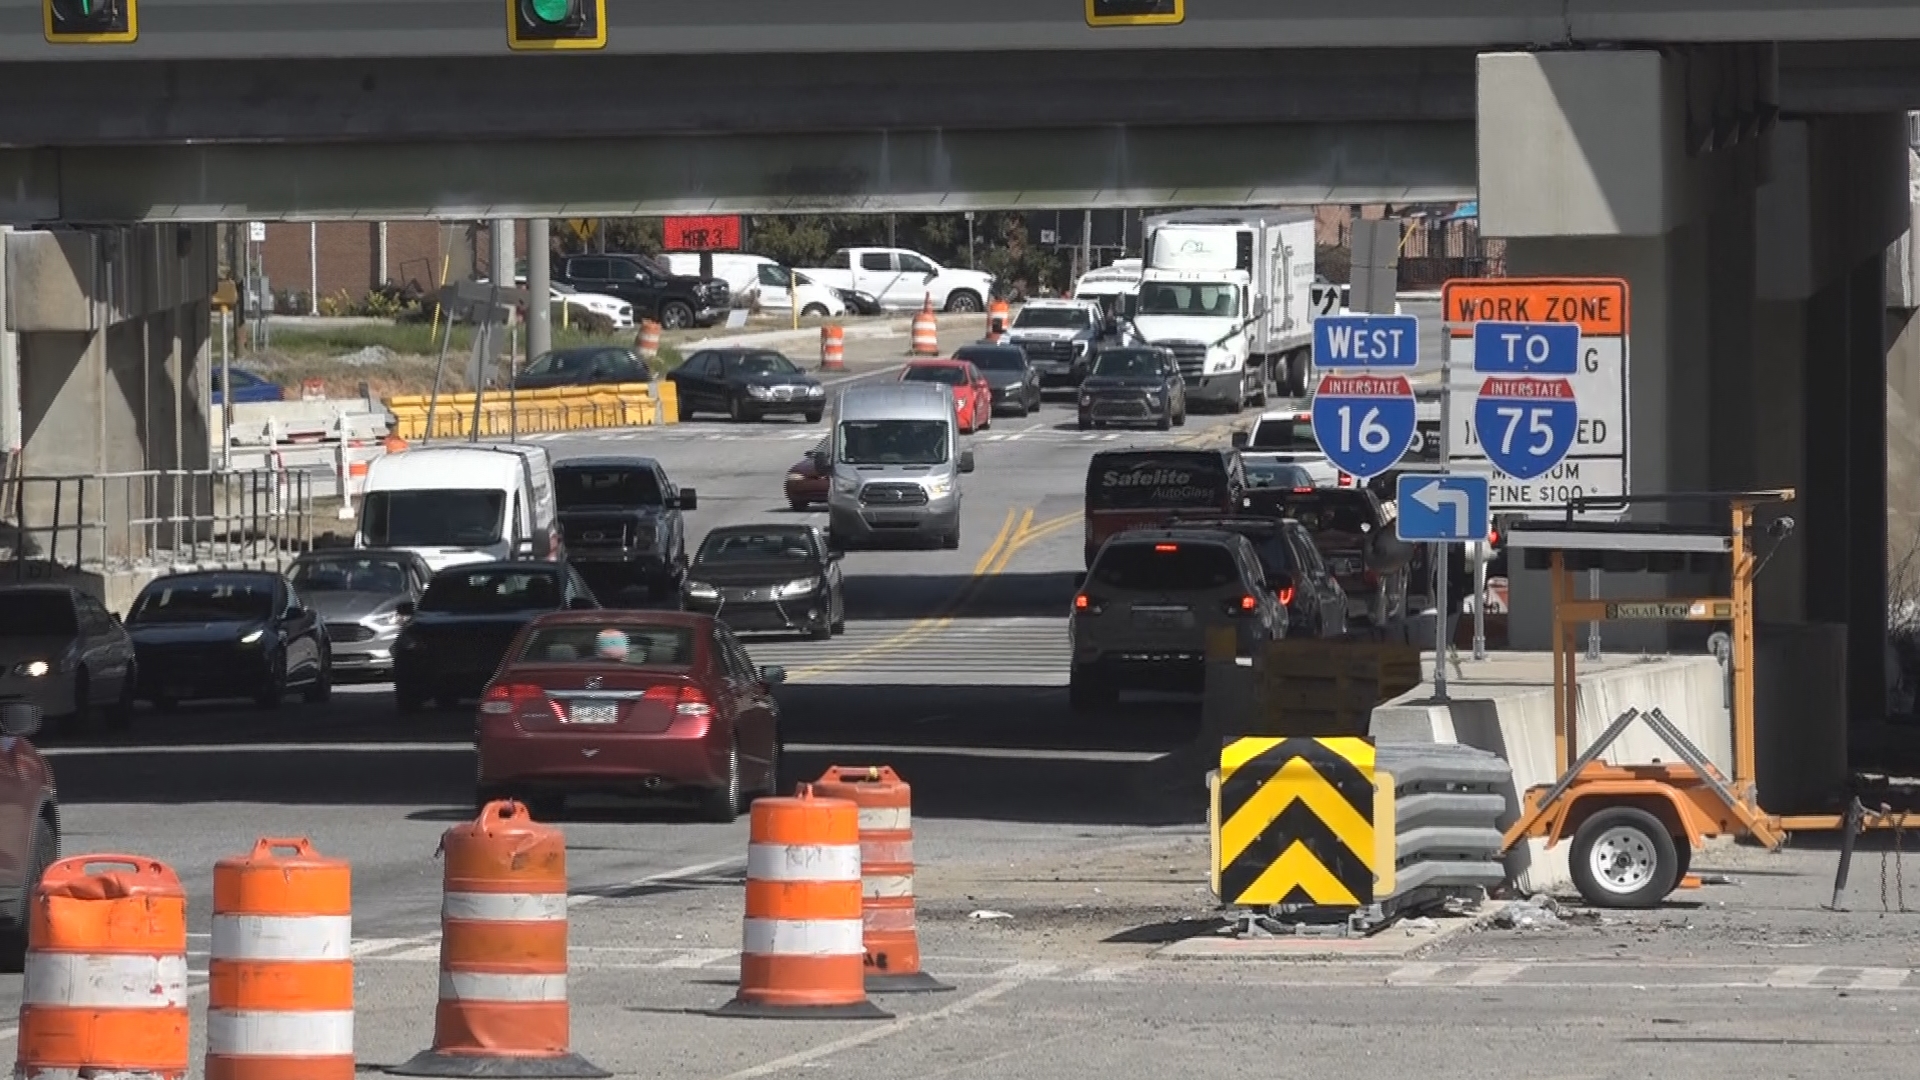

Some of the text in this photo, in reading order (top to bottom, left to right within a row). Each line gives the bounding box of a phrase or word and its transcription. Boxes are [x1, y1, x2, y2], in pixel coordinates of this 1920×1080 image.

[1458, 296, 1612, 321] WORK ZONE
[1327, 325, 1404, 359] WEST
[1500, 333, 1550, 363] TO
[1328, 380, 1401, 395] INTERSTATE
[1490, 381, 1563, 397] INTERSTATE
[1337, 405, 1391, 453] 16
[1497, 407, 1554, 456] 75
[1102, 469, 1190, 487] Safelite
[1489, 485, 1583, 502] FINE $100
